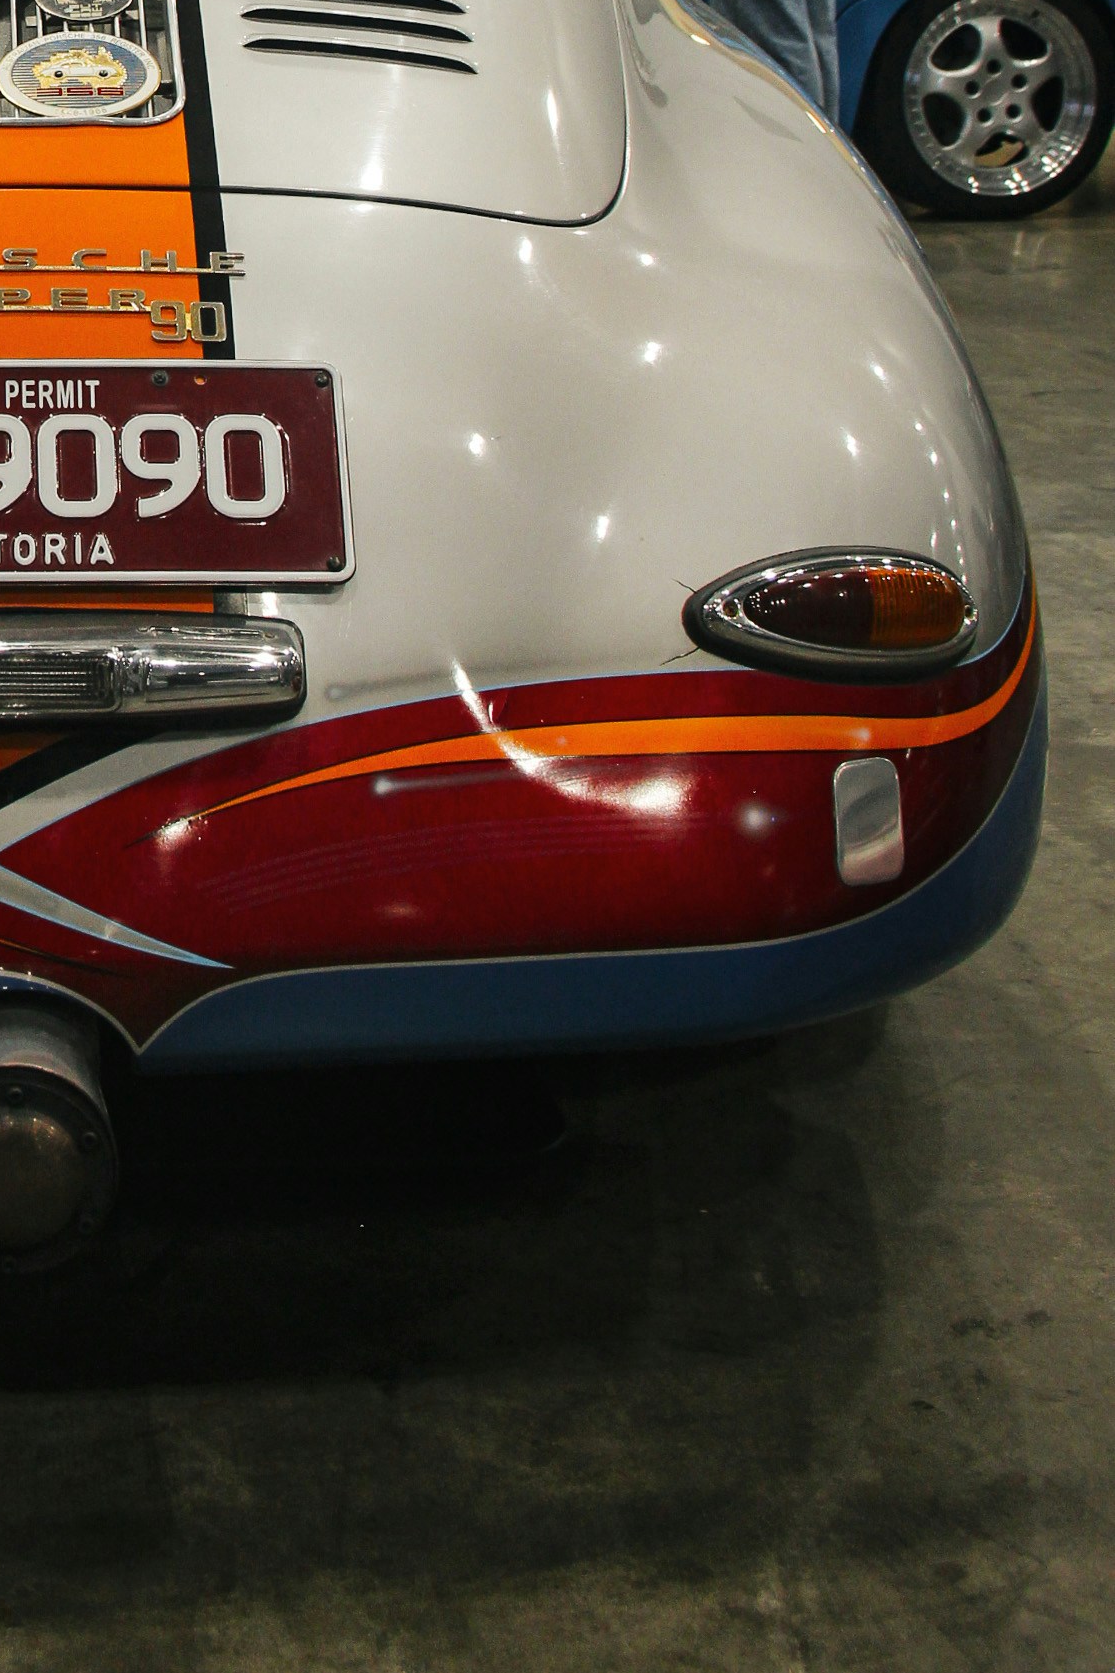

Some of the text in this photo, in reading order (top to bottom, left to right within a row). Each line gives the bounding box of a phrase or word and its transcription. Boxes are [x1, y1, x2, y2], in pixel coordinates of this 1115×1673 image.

[43, 33, 85, 44] PORSCHE
[150, 300, 227, 343] 90
[4, 379, 100, 410] PERMIT
